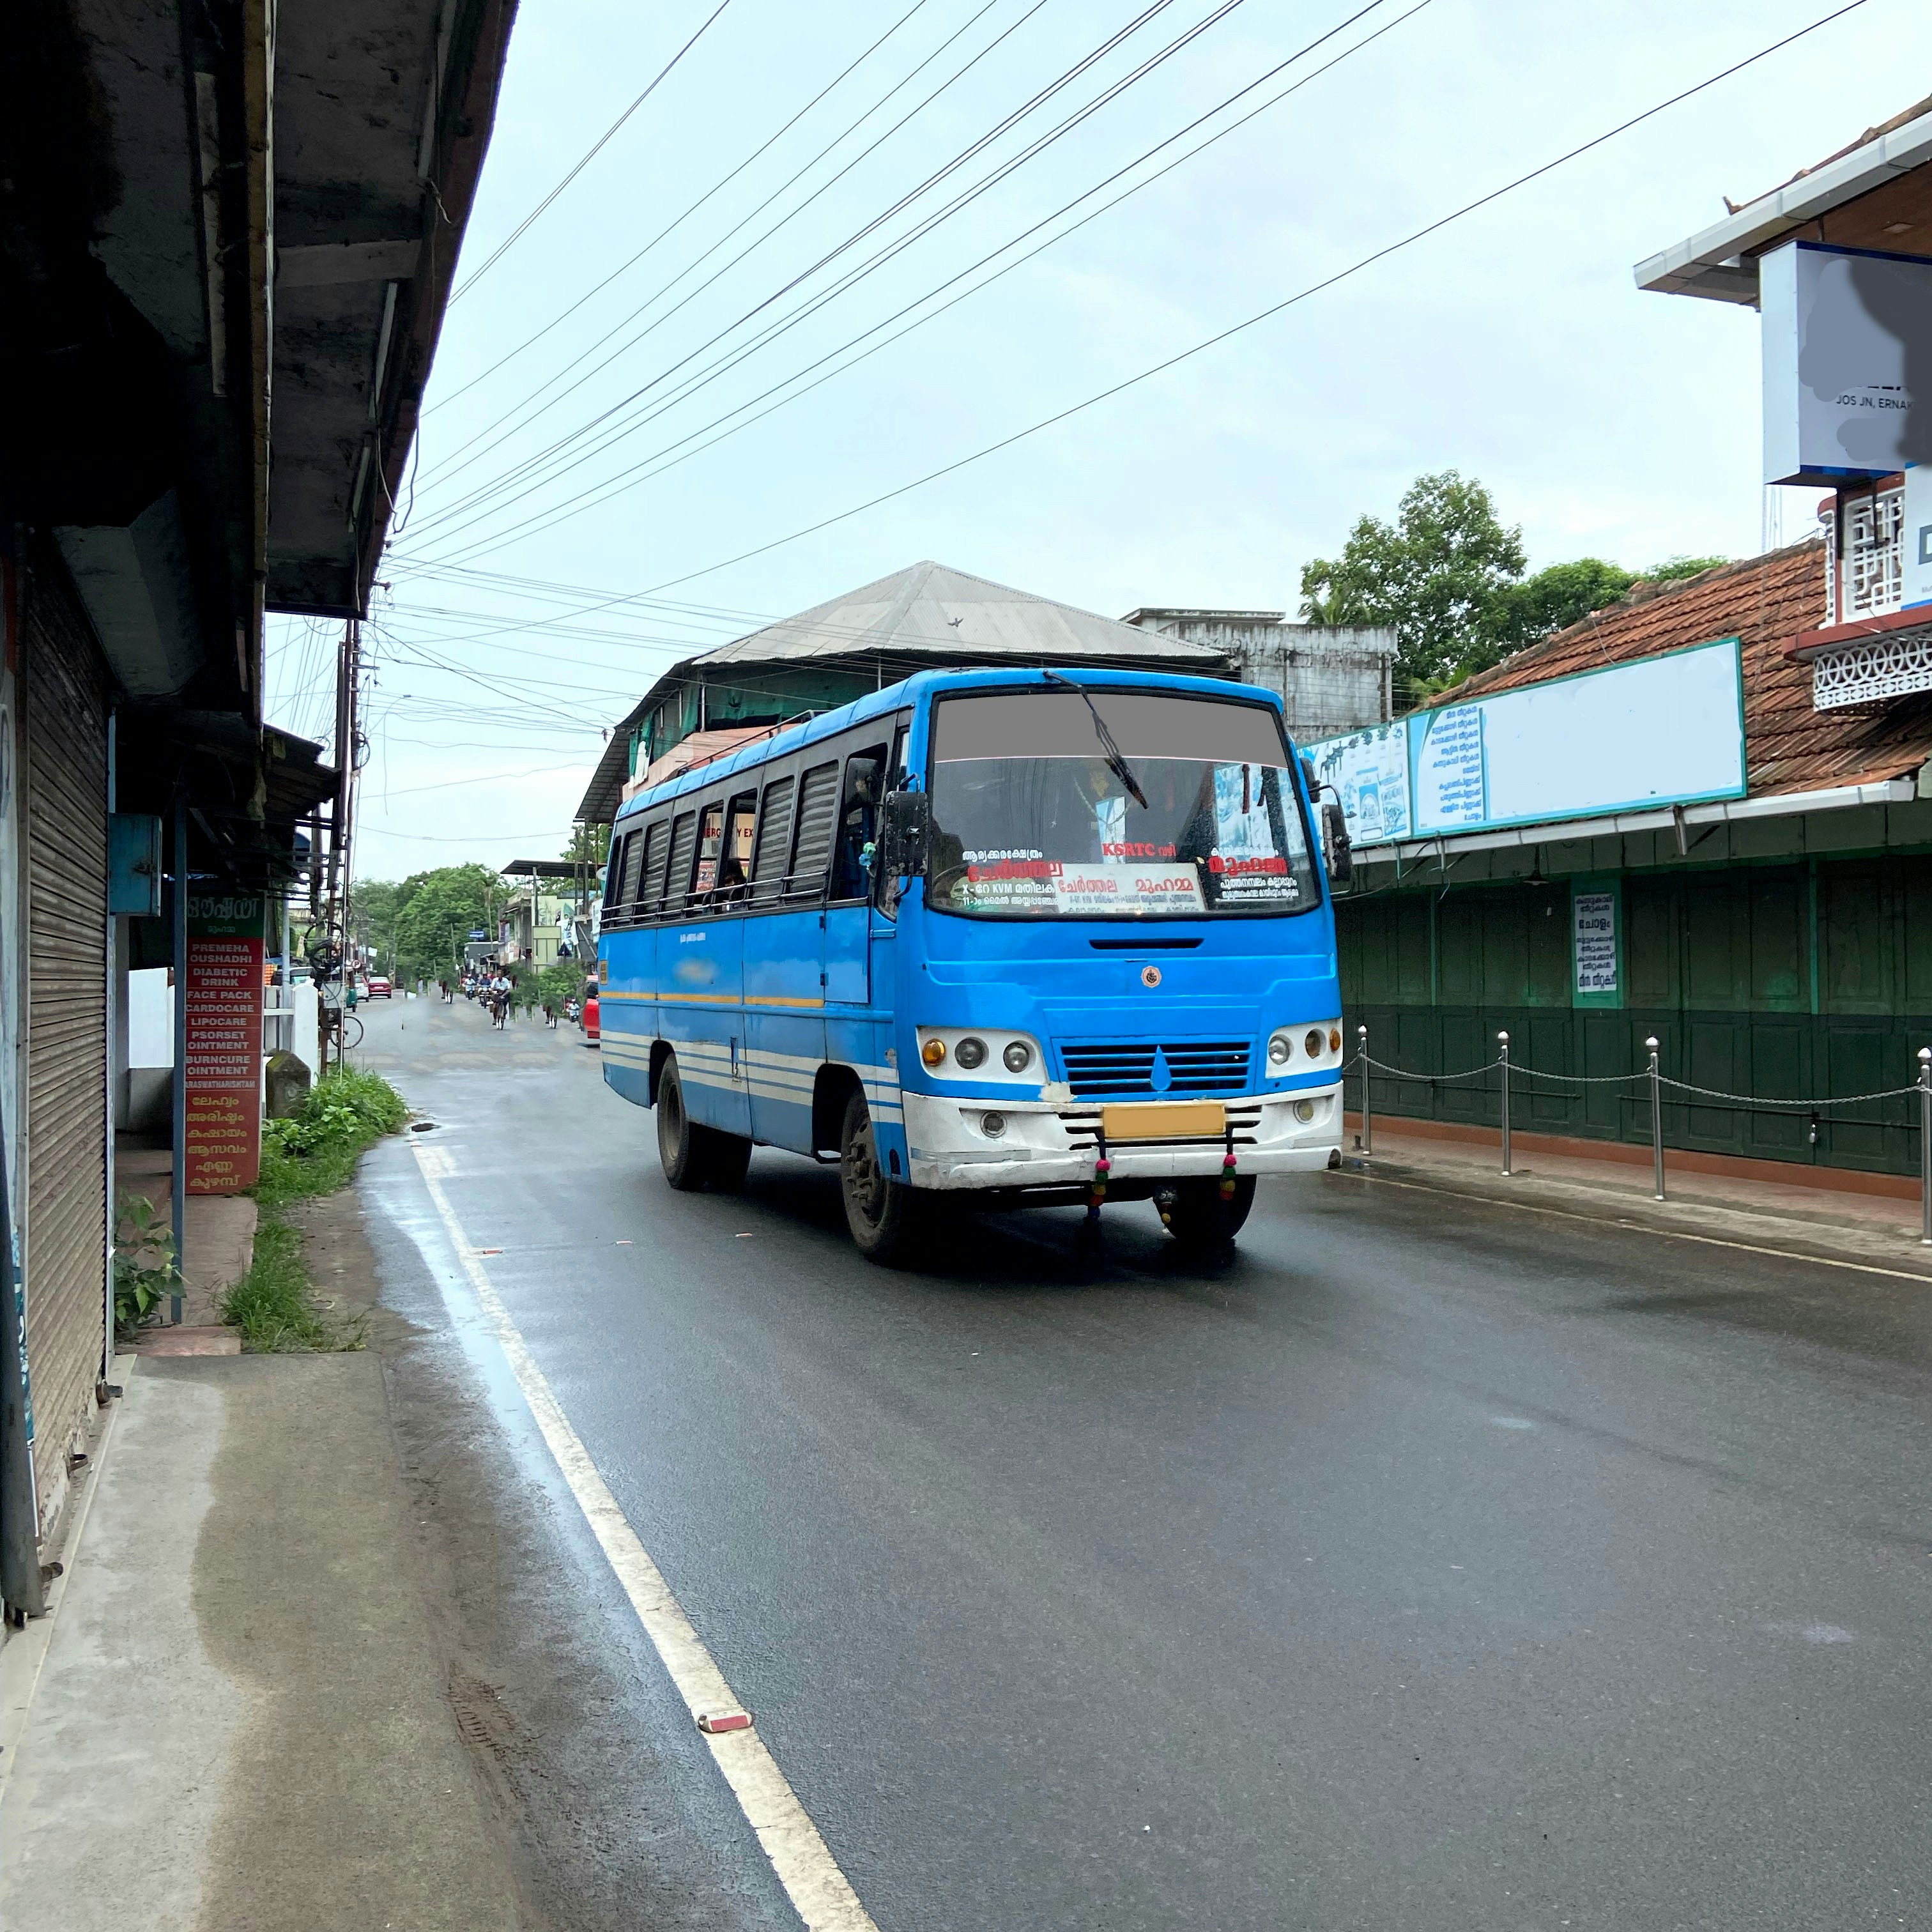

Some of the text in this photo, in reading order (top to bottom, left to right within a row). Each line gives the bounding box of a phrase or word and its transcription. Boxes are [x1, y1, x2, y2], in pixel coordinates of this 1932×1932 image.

[1836, 395, 1857, 406] JOS
[1859, 395, 1876, 409] JN,
[1101, 843, 1156, 857] KSRTC
[992, 883, 1012, 894] KVM
[1058, 875, 1194, 894] ചേർത്തല മുഹമ്മ
[192, 944, 250, 953] PREMEHA
[190, 954, 252, 963] OUSHADHI
[193, 968, 248, 977] DIABETIC
[201, 978, 239, 986] DRINK
[187, 991, 252, 999] FACE PACK
[186, 1004, 254, 1013] CARDOCARE
[191, 1018, 247, 1026] LIPOCARE
[192, 1031, 246, 1039] PSORSET
[187, 1041, 249, 1050] OINTMENT
[186, 1055, 250, 1064] BURNCURE
[187, 1066, 249, 1075] OINTMENT
[185, 1080, 256, 1089] ARASWATHARISHTAM
[192, 1096, 239, 1107] ലേഹ്യം
[187, 1129, 247, 1138] കഷായം
[188, 1144, 247, 1157] ആസവം
